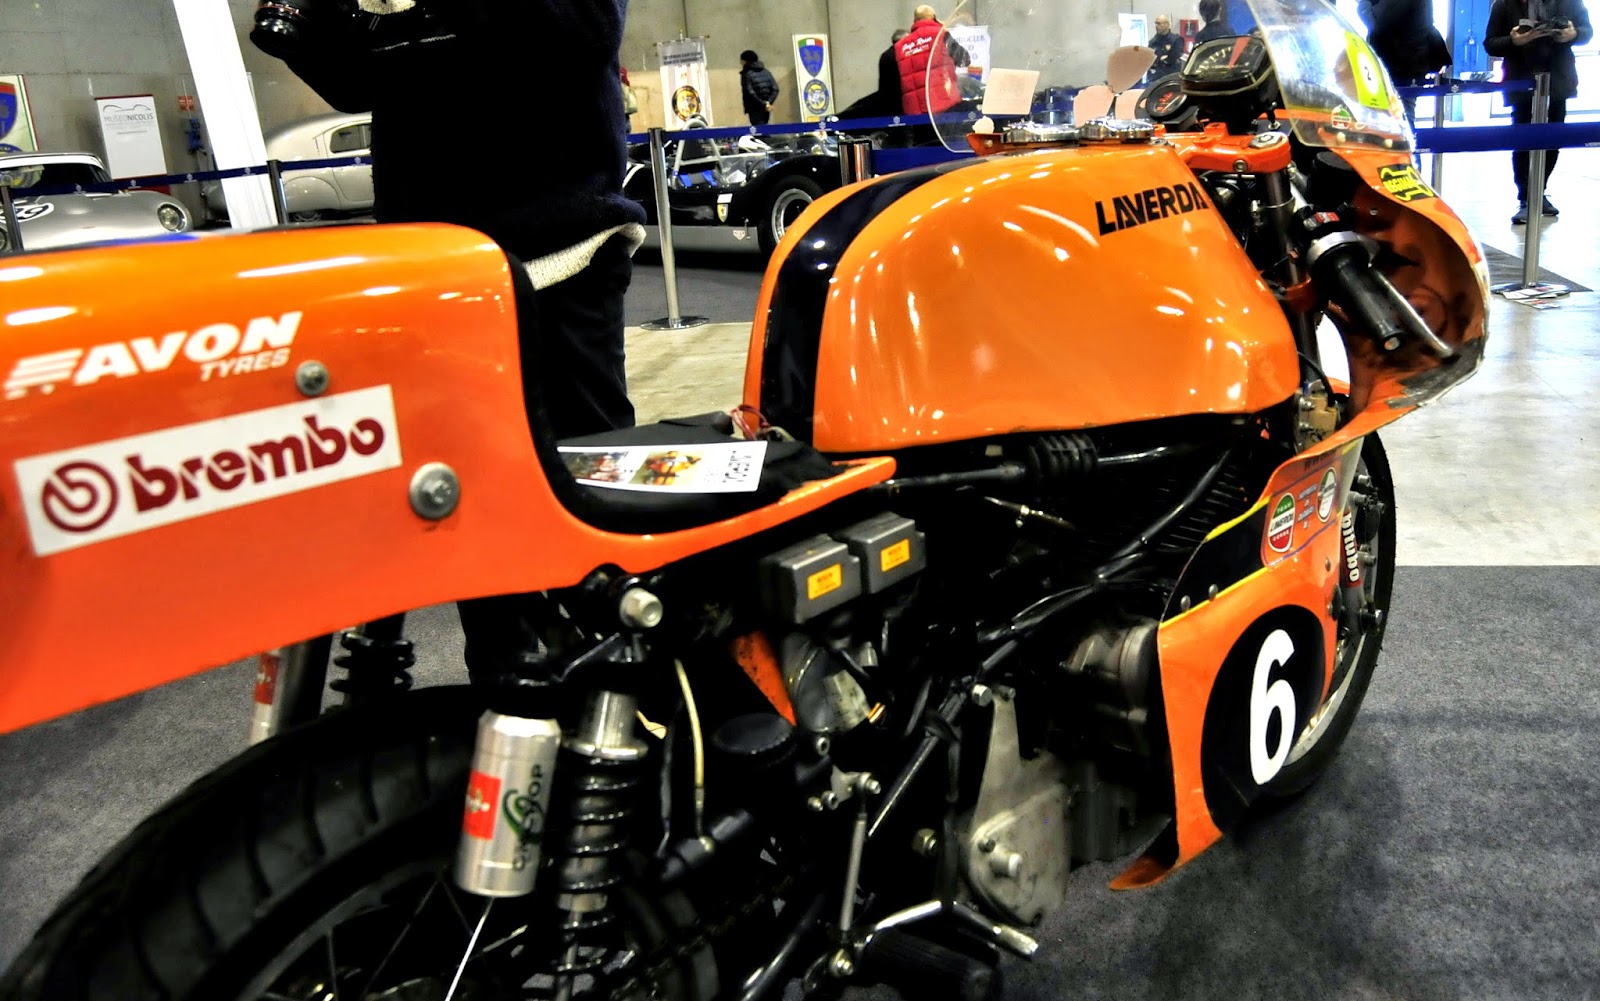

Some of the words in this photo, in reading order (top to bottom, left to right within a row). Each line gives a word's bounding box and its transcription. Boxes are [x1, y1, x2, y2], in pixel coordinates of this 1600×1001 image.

[1095, 181, 1209, 236] LAVERDA
[74, 311, 302, 383] AVON
[200, 347, 291, 382] TYRES
[126, 414, 386, 514] brembo
[1341, 511, 1360, 582] bitubo
[1250, 628, 1296, 785] 6
